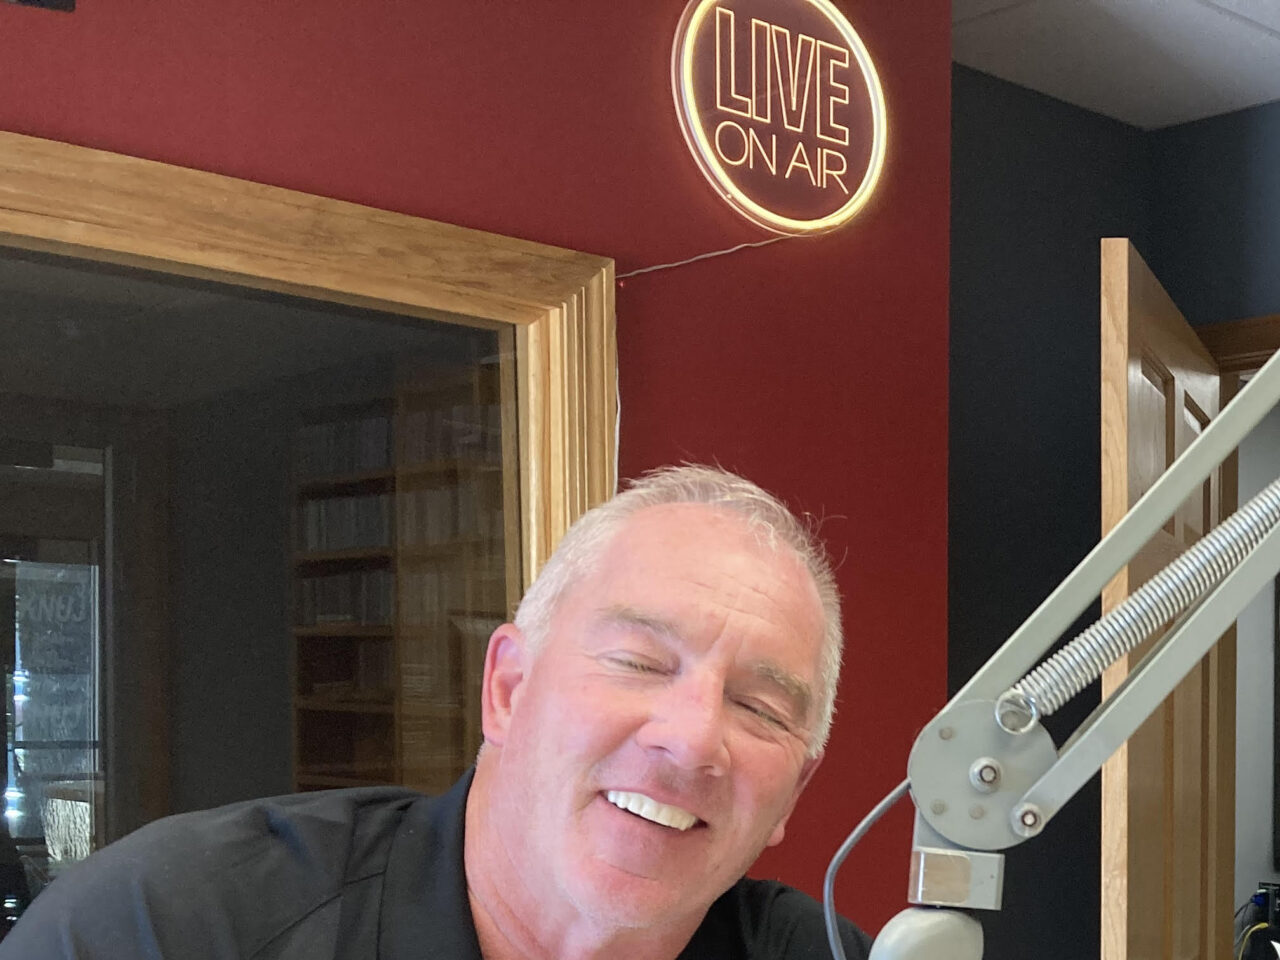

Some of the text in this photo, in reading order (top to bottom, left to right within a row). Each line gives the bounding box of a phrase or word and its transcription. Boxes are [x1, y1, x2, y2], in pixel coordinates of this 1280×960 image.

[716, 6, 849, 146] LIVE
[715, 121, 849, 195] ON AIR
